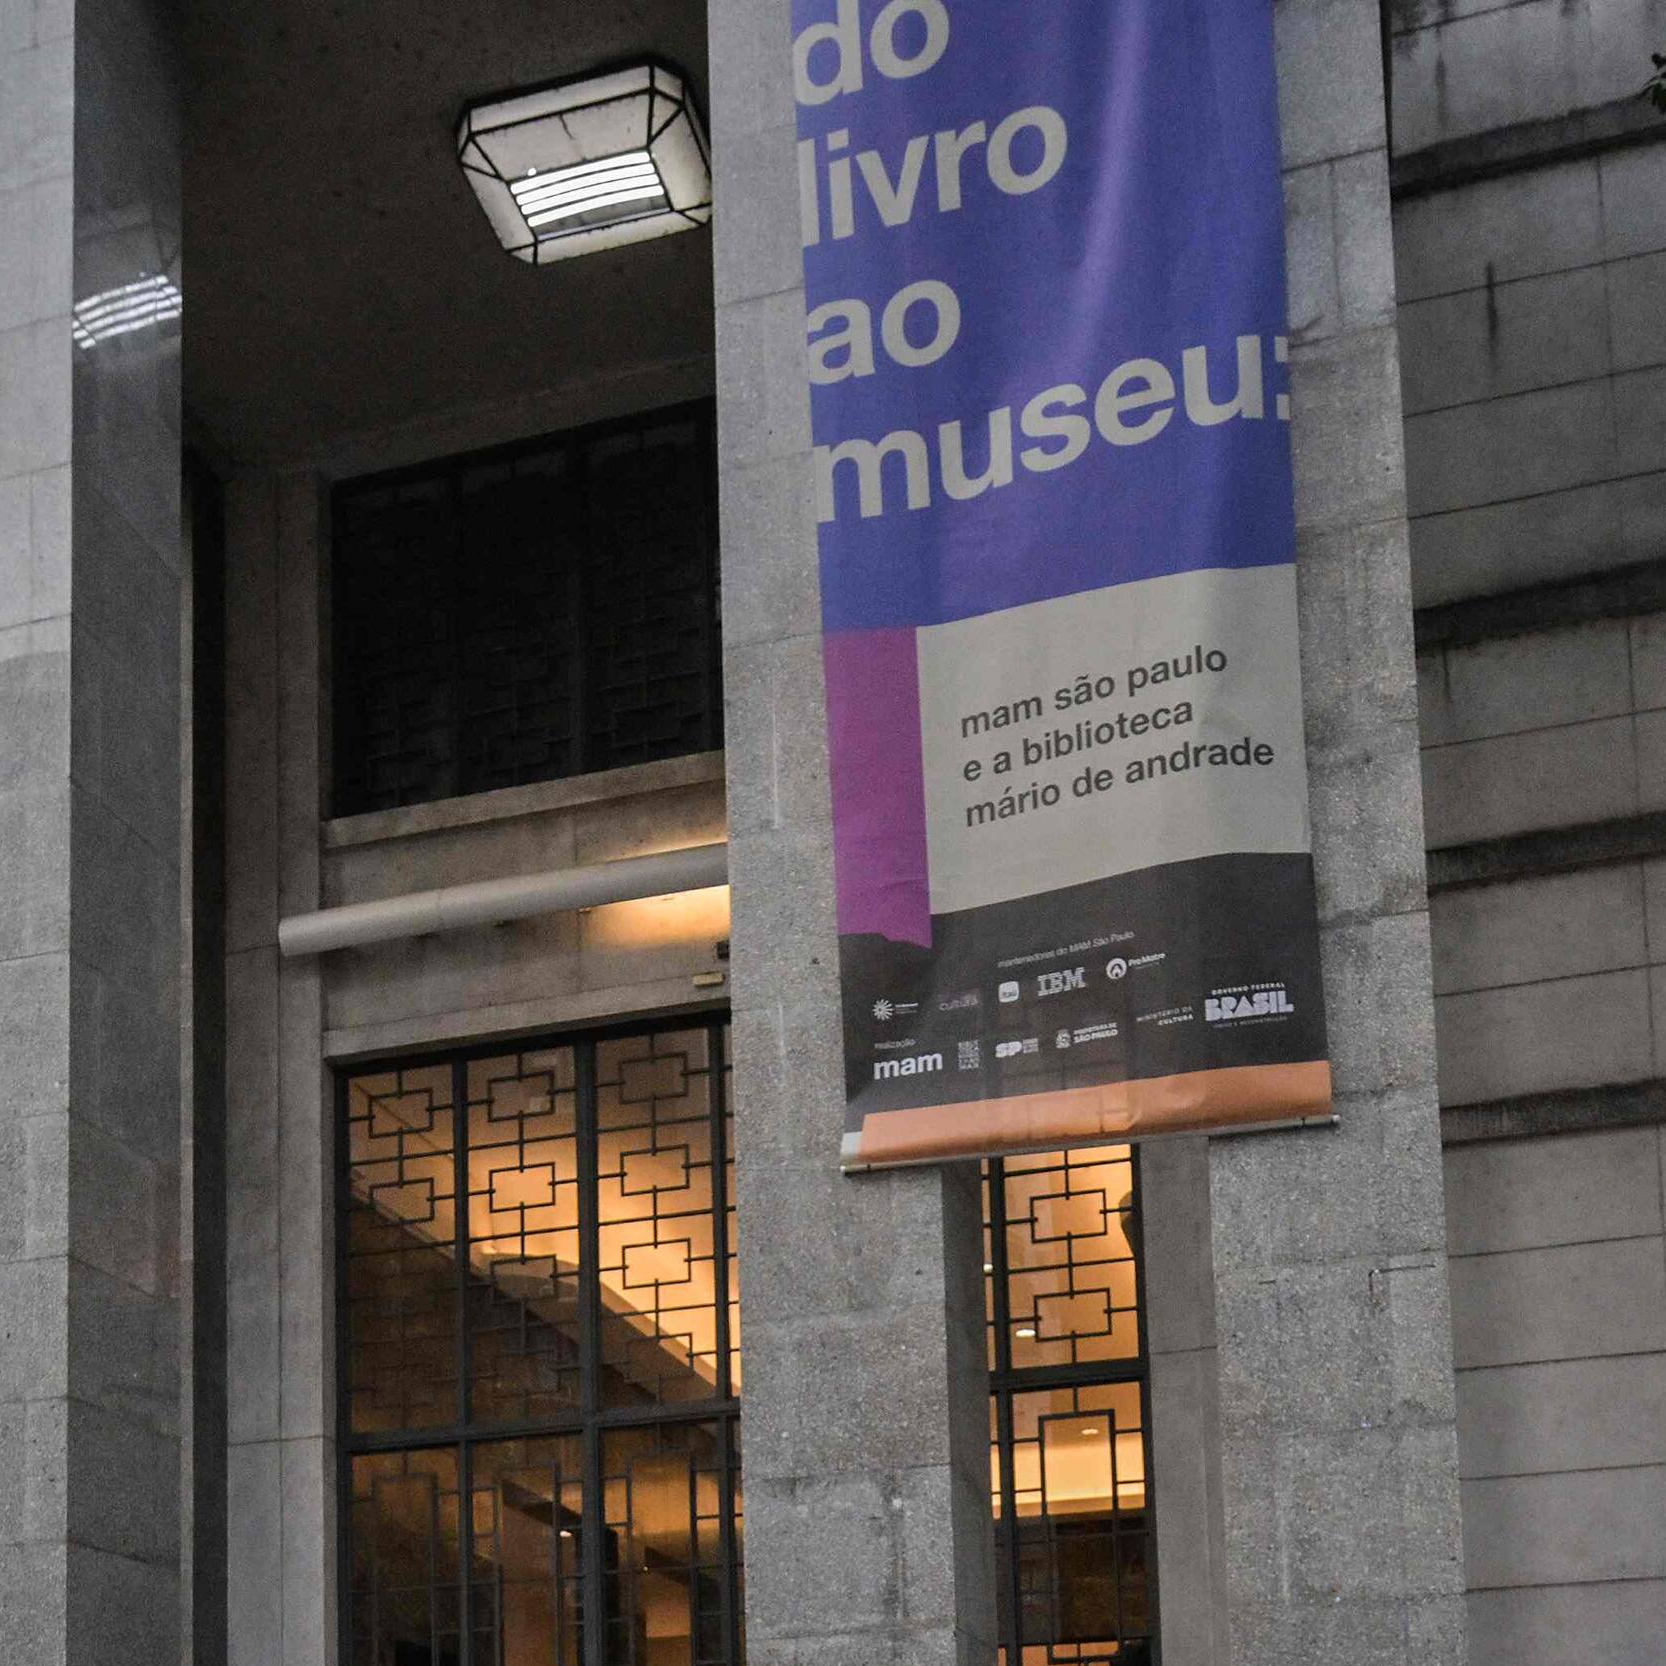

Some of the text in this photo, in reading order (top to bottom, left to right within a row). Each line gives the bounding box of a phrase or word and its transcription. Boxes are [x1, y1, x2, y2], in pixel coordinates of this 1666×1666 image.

[793, 0, 950, 105] do
[797, 105, 1068, 248] livro
[807, 279, 961, 386] ao
[961, 645, 1228, 738] mam são paulo
[963, 701, 1194, 782] e a biblioteca
[966, 736, 1275, 828] mário de andrade
[1037, 967, 1085, 997] IBM
[1205, 990, 1295, 1022] BRASIL
[874, 1053, 943, 1081] mam
